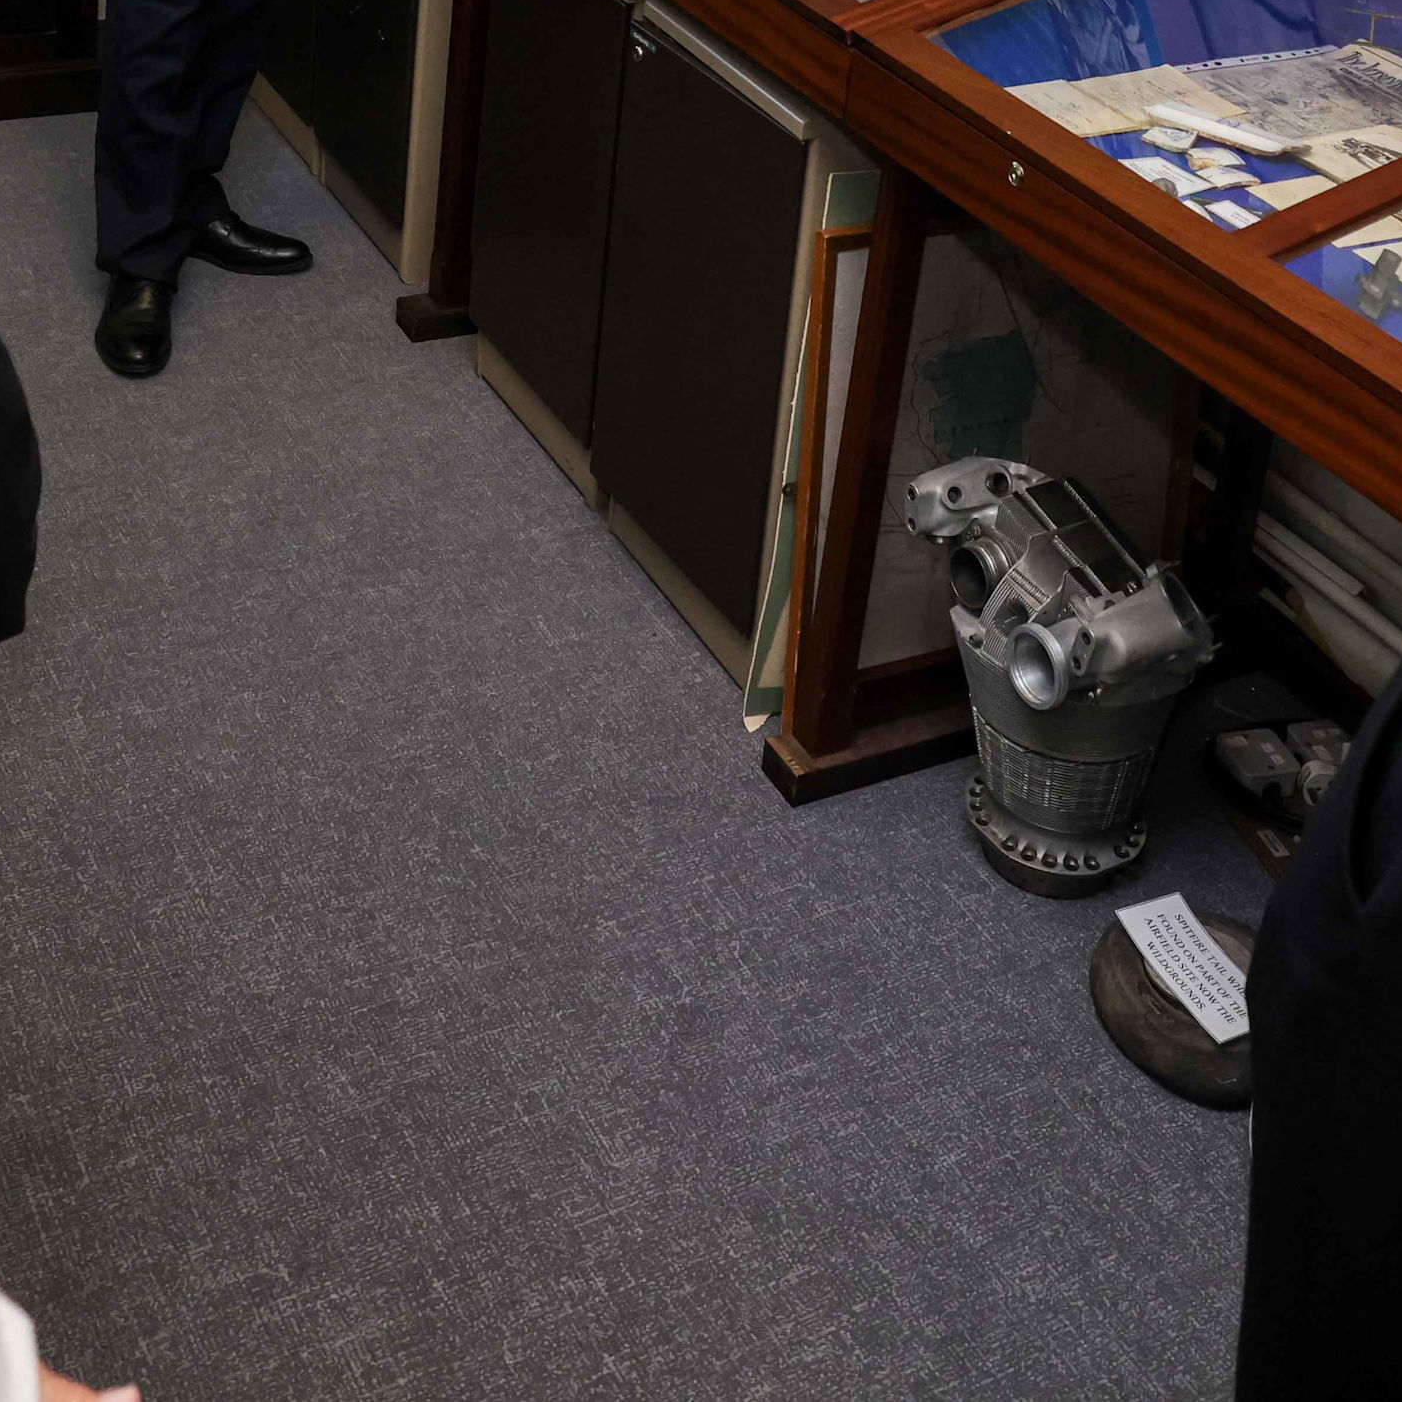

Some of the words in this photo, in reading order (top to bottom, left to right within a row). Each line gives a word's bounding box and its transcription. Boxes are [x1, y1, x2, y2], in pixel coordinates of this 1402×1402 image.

[1144, 917, 1181, 963] AIRFIELD
[1177, 962, 1199, 985] SITE
[1197, 983, 1220, 1005] NOW
[1217, 1004, 1236, 1025] THE
[1147, 941, 1207, 1012] WILDGROUNDS.
[1157, 913, 1185, 949] FOUND
[1183, 948, 1198, 965] ON
[1195, 964, 1218, 988] PART
[1217, 986, 1231, 1000] OF
[1230, 999, 1249, 1019] THE
[1175, 913, 1210, 955] SPITFIRE
[1207, 954, 1227, 977] TAIL
[1228, 976, 1246, 998] WHE
